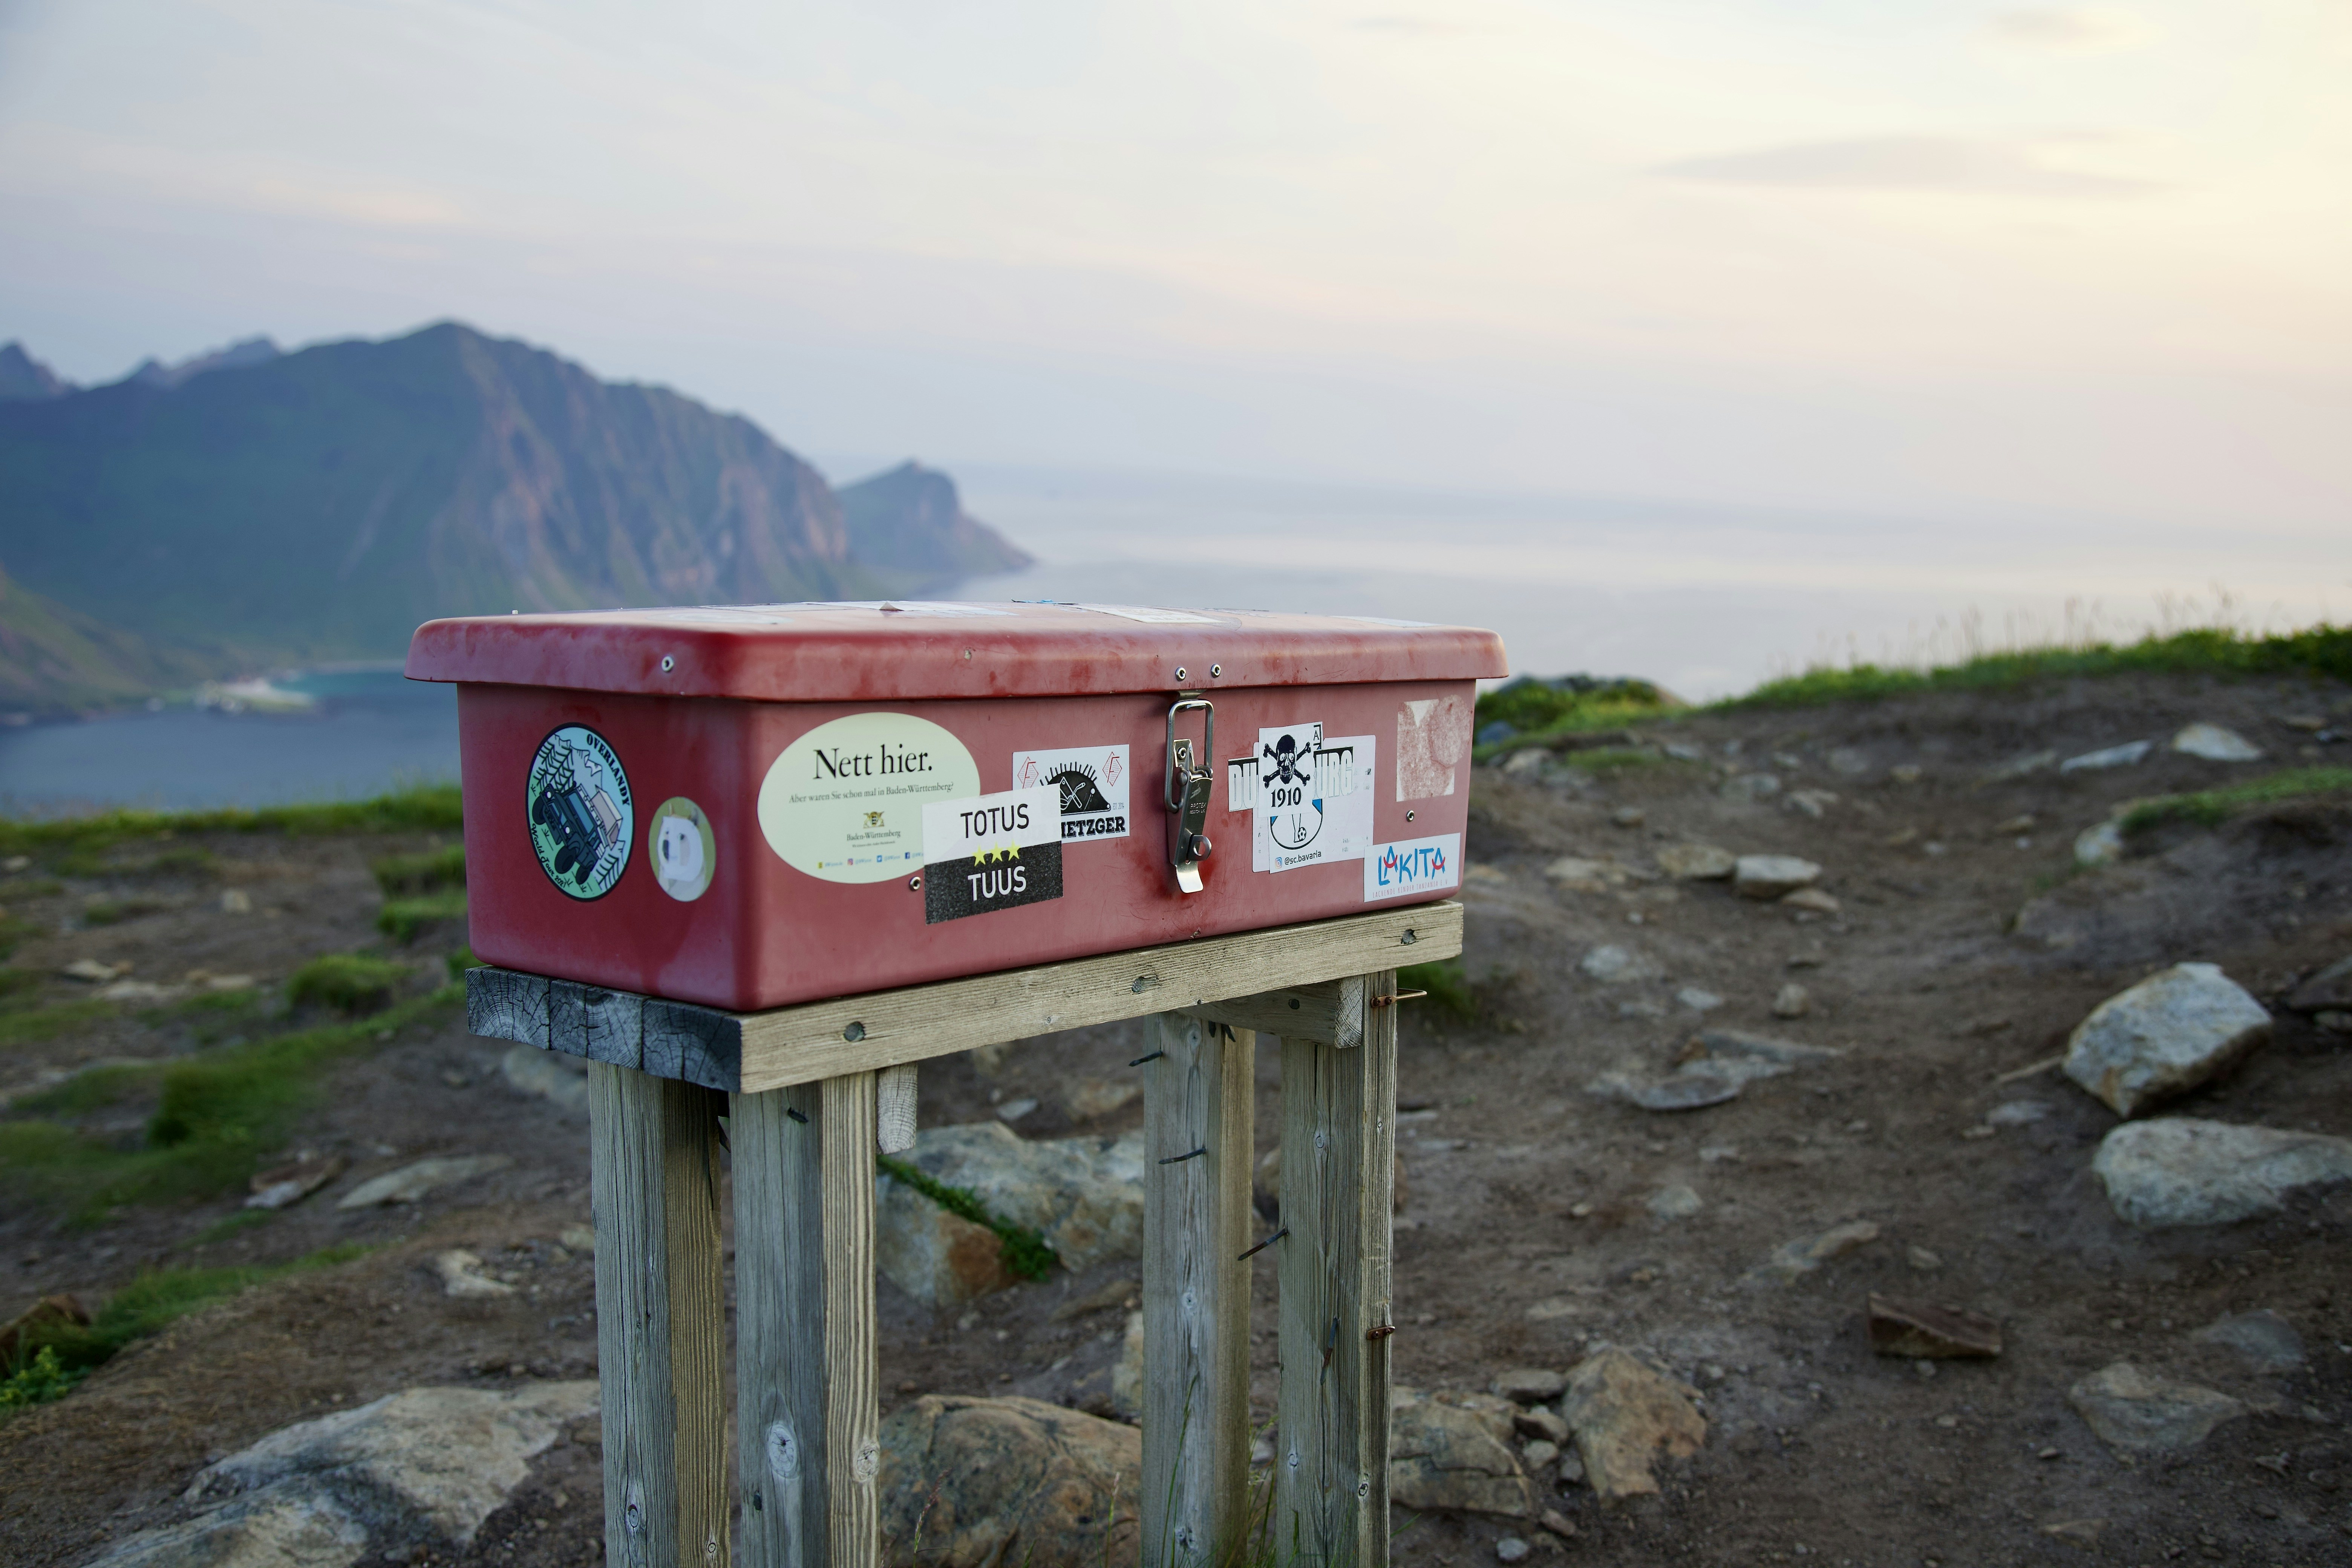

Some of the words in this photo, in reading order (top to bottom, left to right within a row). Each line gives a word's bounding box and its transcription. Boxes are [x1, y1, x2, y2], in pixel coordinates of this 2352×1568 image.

[586, 733, 630, 806] OVERLANDY
[813, 748, 873, 779] Nett
[880, 743, 933, 774] hier.
[789, 795, 807, 803] Aber
[831, 791, 841, 799] Sie
[842, 789, 862, 799] schon
[864, 788, 876, 797] mal
[886, 781, 954, 795] Baden-Württemberg?
[1271, 787, 1302, 808] 1910
[847, 830, 901, 842] Baden-Württemberg
[960, 804, 1029, 838] TOTUS
[531, 823, 545, 855] World
[540, 856, 555, 877] Tour
[1284, 850, 1322, 865] @sc.bavaria
[1378, 845, 1446, 886] LAKITA
[967, 866, 1026, 901] TUUS
[1372, 888, 1395, 898] LACHENDE
[1398, 885, 1414, 894] KINDER
[1416, 880, 1438, 890] TANZANIA
